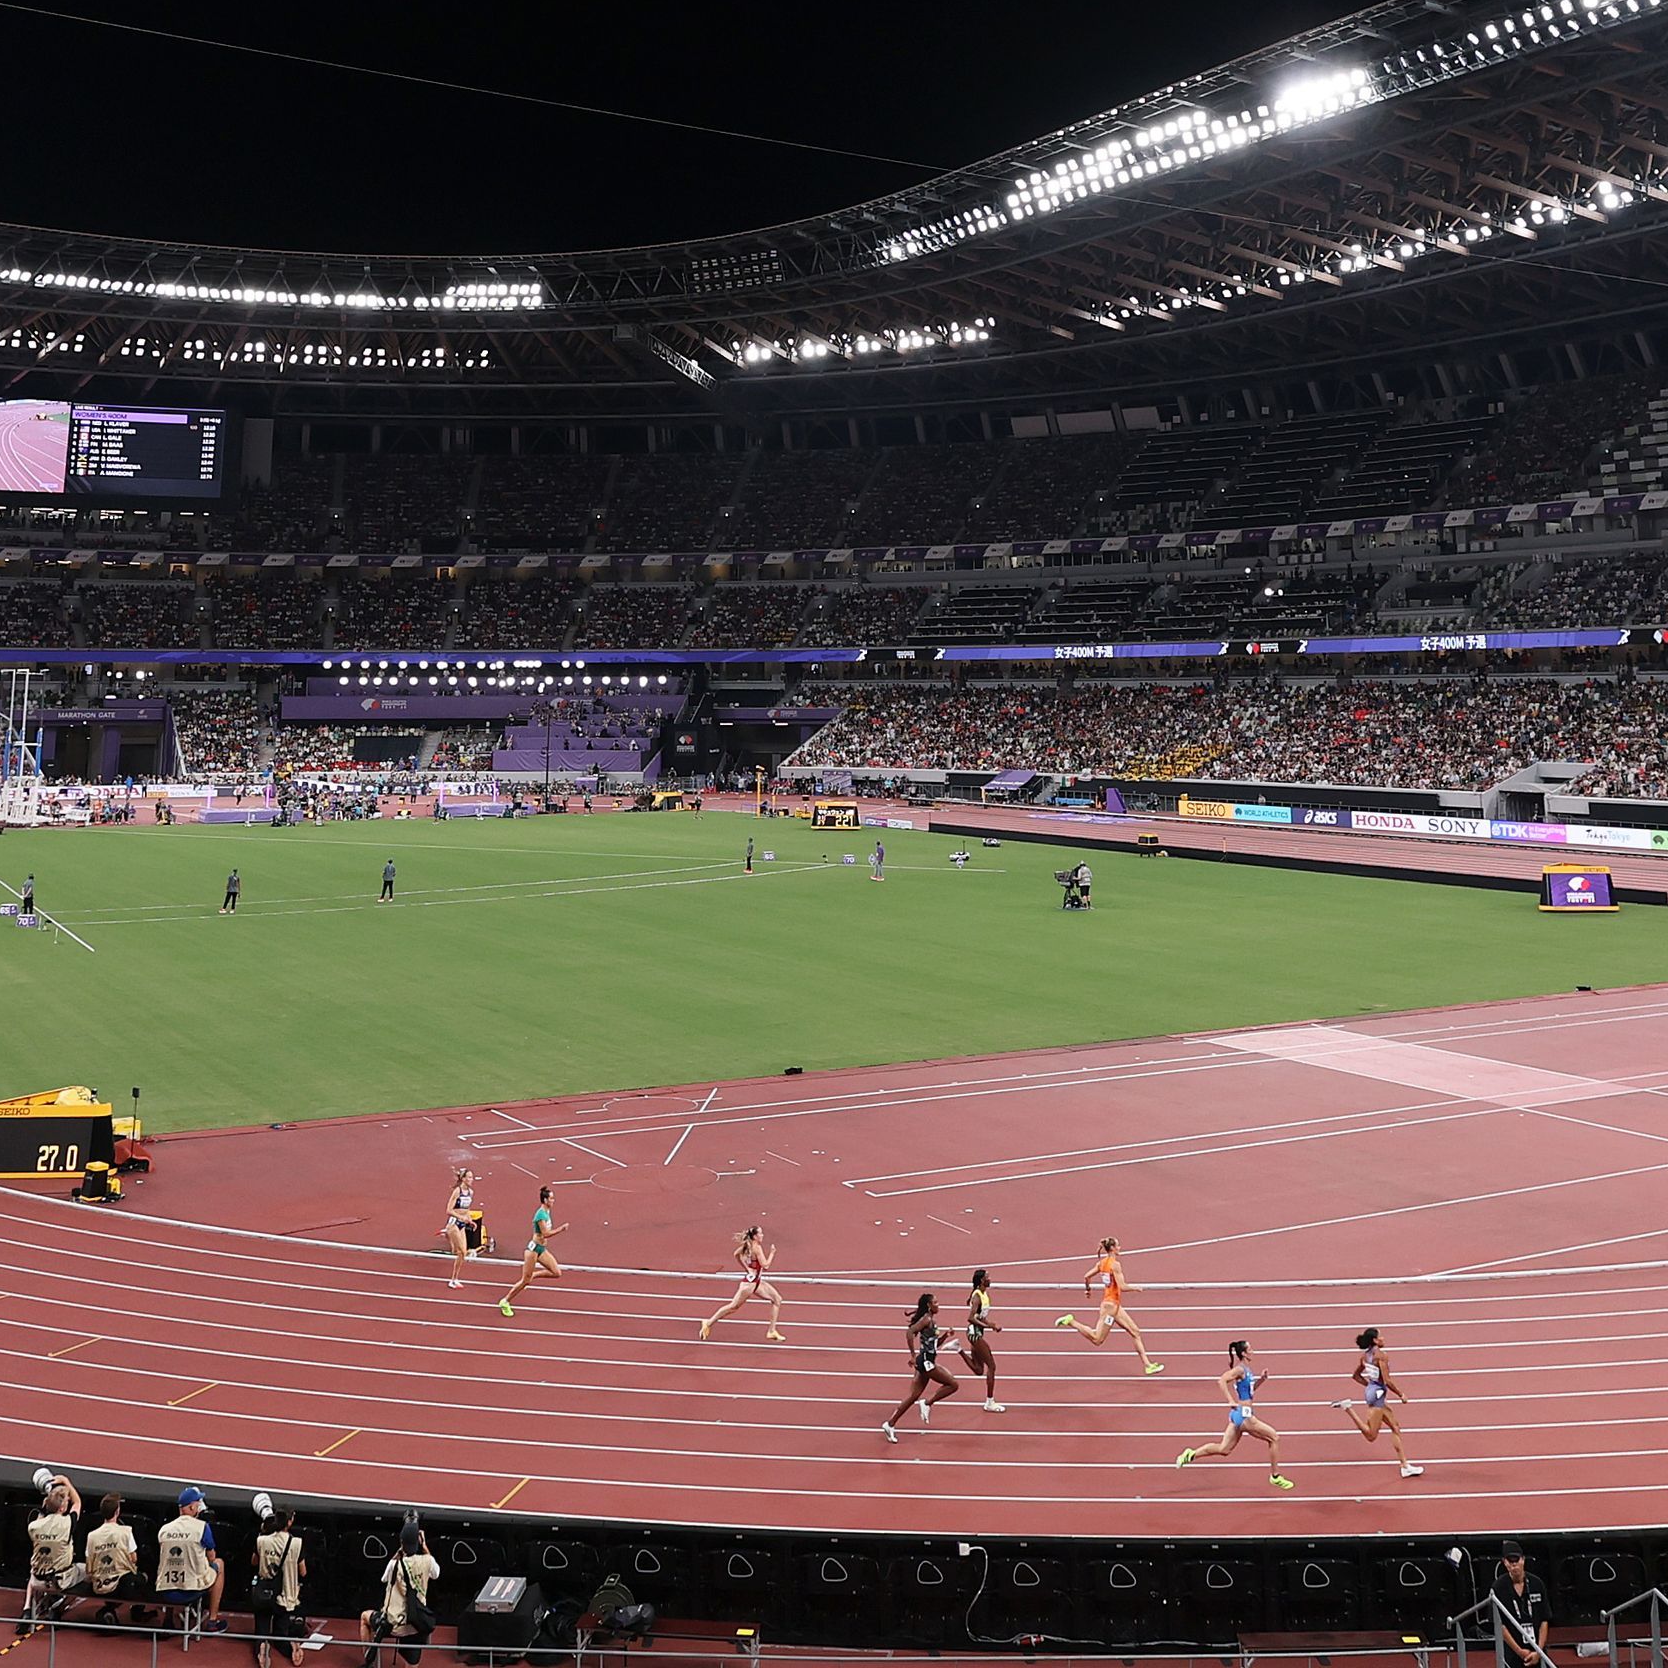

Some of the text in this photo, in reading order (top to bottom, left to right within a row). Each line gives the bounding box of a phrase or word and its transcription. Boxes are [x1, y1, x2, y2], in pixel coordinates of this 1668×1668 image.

[1420, 635, 1487, 651] 女子400M 予選
[1054, 645, 1114, 659] 女子400M 予選
[99, 711, 116, 719] GATE
[1186, 803, 1226, 817] SEIKO
[1244, 809, 1289, 819] WORLD ATHLETICS
[836, 816, 853, 827] 221
[1314, 811, 1338, 825] asics
[1355, 814, 1480, 834] HONDA SONY
[1499, 824, 1528, 838] TDK
[1586, 829, 1631, 844] Tokyo Tokyo
[36, 1144, 78, 1172] 27.0
[35, 1533, 58, 1541] SONY
[94, 1542, 118, 1551] SONY
[265, 1549, 282, 1558] SON
[164, 1570, 186, 1583] 131
